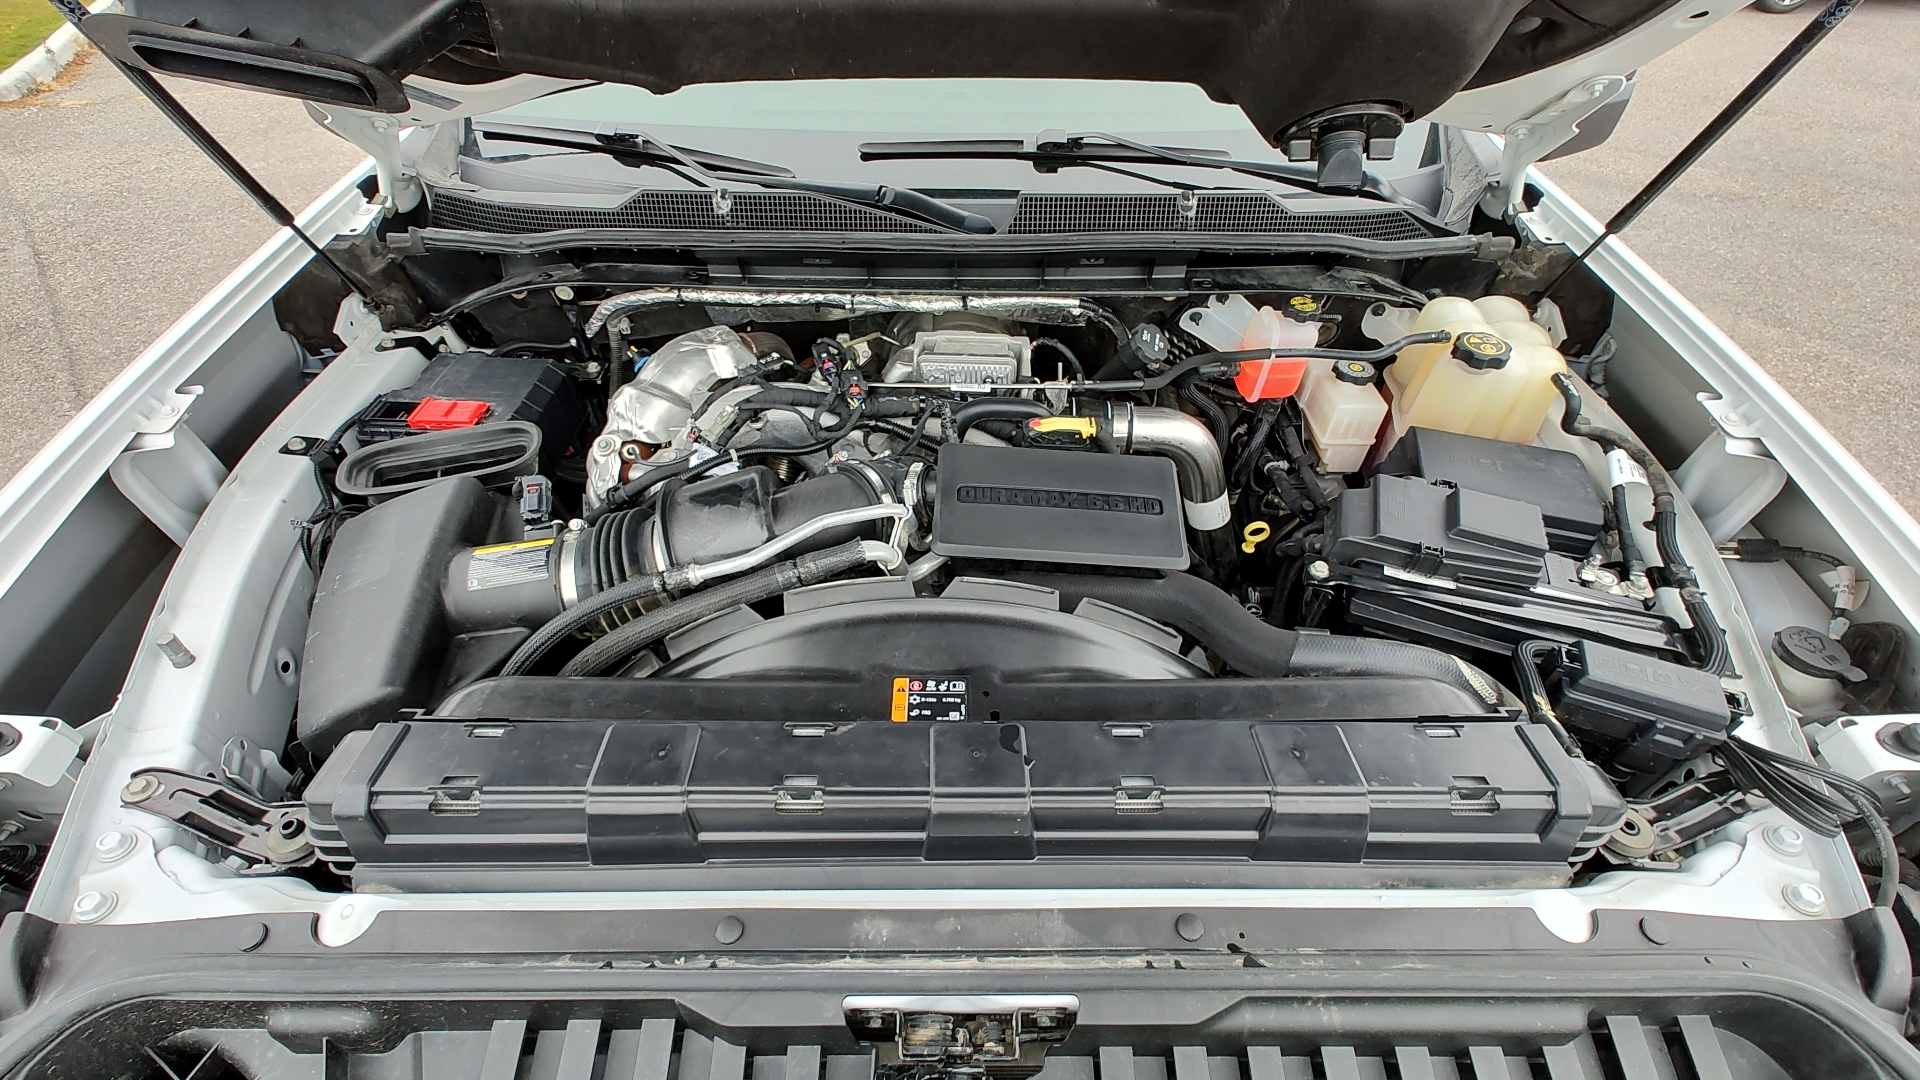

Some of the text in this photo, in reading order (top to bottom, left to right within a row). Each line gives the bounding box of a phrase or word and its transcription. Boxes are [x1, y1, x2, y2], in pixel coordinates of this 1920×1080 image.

[960, 487, 1162, 514] DURAMAX 6.6 HD
